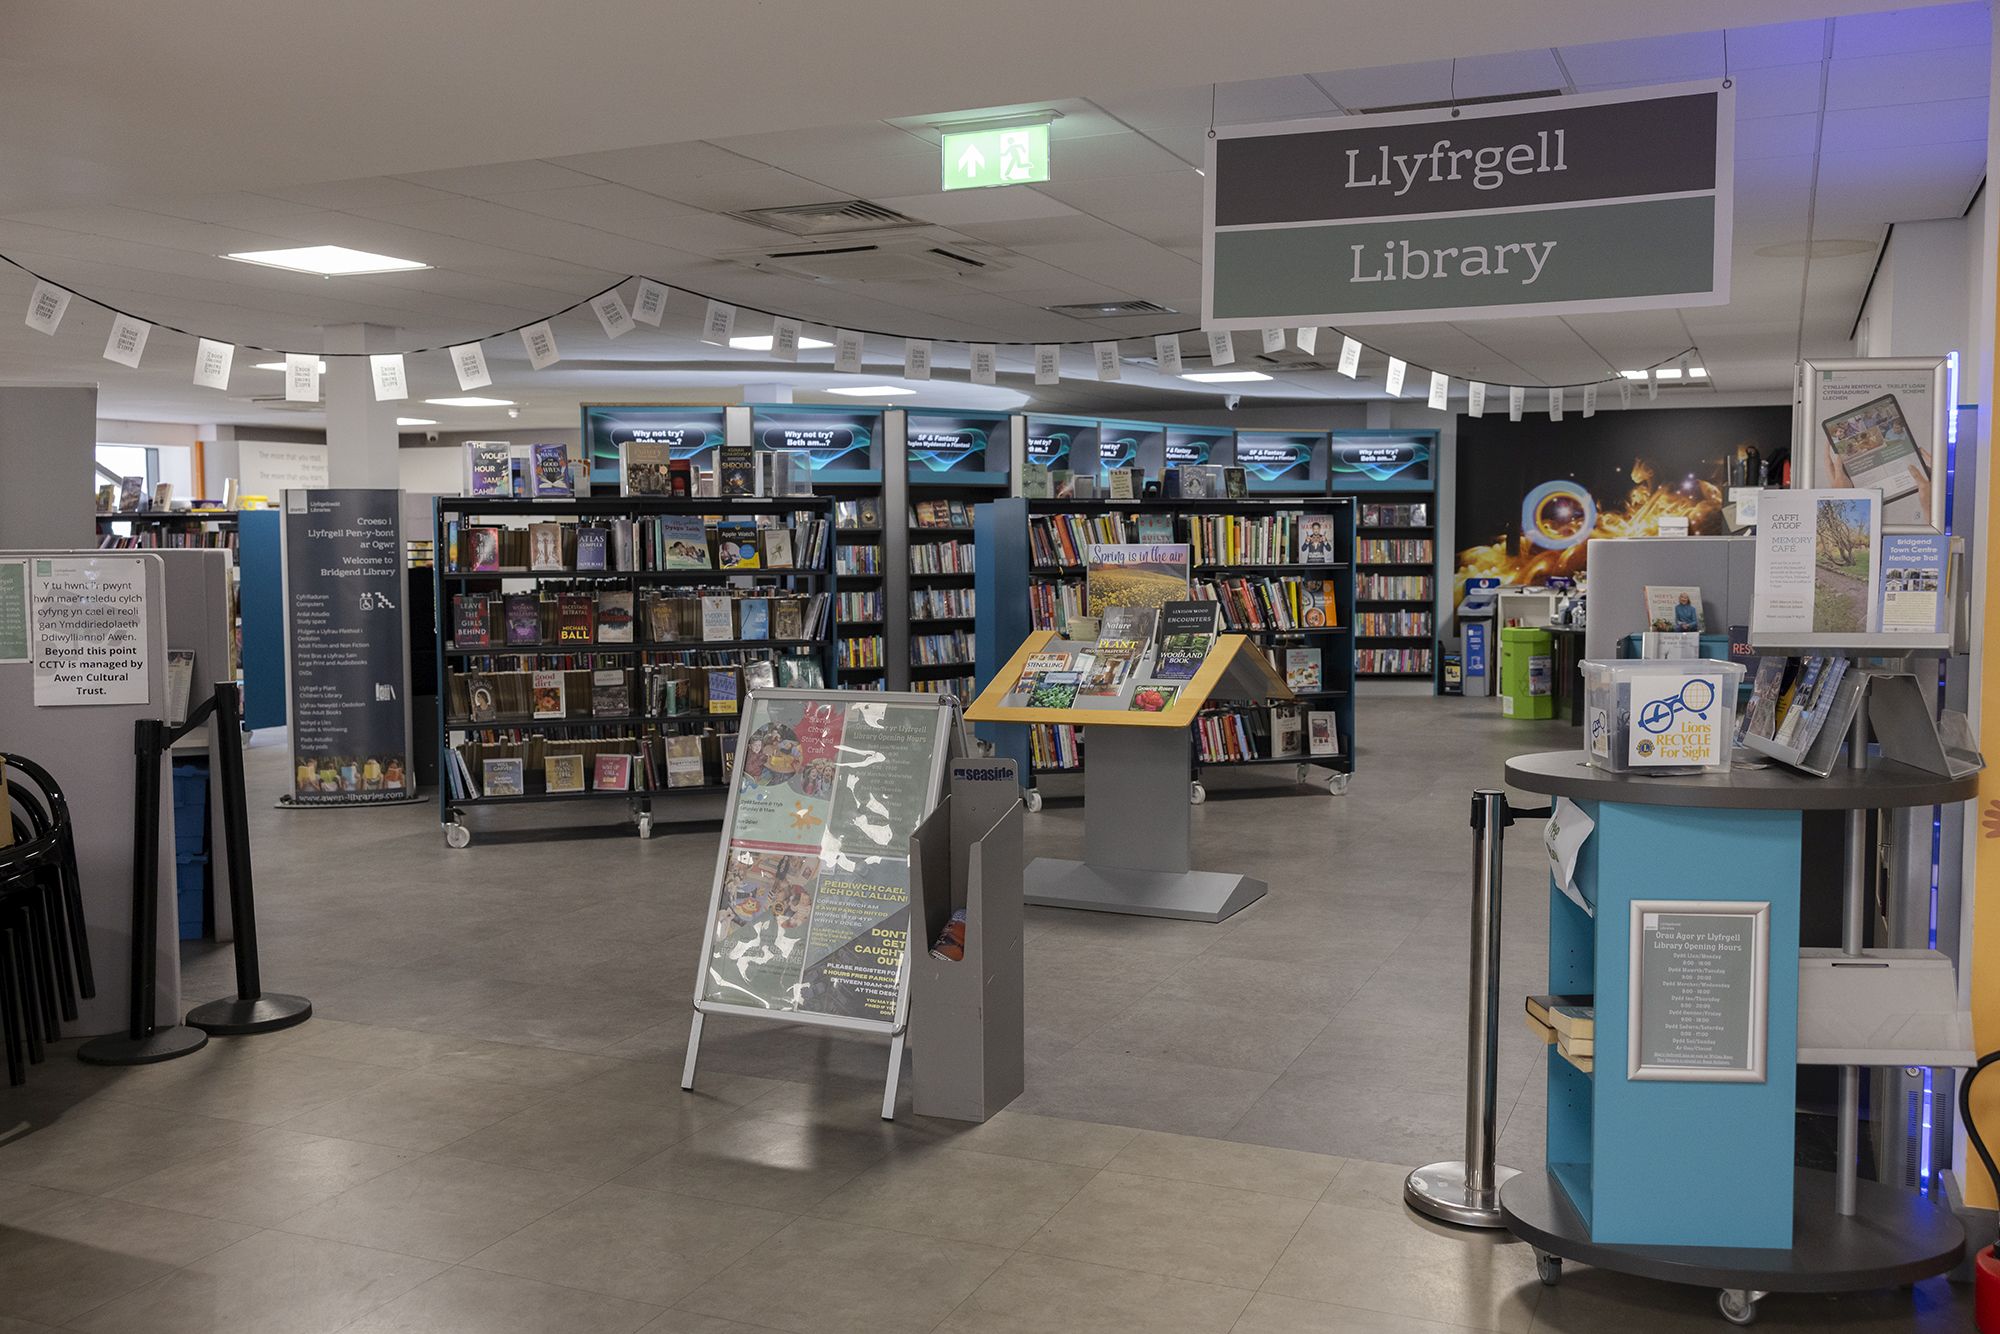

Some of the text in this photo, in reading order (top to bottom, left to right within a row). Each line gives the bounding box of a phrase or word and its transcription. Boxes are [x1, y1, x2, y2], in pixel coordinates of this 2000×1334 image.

[1345, 129, 1567, 196] Llyfrgell
[1350, 240, 1557, 284] Library
[632, 430, 650, 438] Why
[667, 430, 684, 438] try?
[784, 431, 801, 440] Why
[818, 431, 834, 440] try?
[934, 434, 960, 443] Fantasy
[481, 452, 508, 460] VIOLET
[1385, 449, 1399, 457] try?
[357, 517, 387, 525] Croeso
[1772, 514, 1800, 522] CAFFI
[308, 529, 394, 539] Llyfrgell Pen-y-bont
[579, 535, 605, 543] ATLAS
[1771, 536, 1813, 544] MEMORY
[1897, 538, 1932, 546] Bridgend
[372, 541, 395, 550] Ogwr
[342, 556, 382, 564] Welcome
[1093, 545, 1184, 567] Spring is in the air
[1888, 554, 1938, 563] Heritage Trail
[321, 568, 395, 577] Bridgend Library
[102, 582, 132, 591] pwynt
[34, 594, 54, 602] hwn
[86, 594, 116, 602] teledu
[119, 594, 142, 604] cylch
[38, 608, 68, 617] cyfyng
[71, 609, 82, 617] yn
[39, 620, 138, 630] gan Ymddiriedolaeth
[1105, 622, 1132, 630] Nature
[41, 633, 105, 643] Ddiwylliannol
[561, 631, 590, 640] BALL
[1098, 640, 1139, 649] PLANT
[45, 647, 136, 657] Beyond this point
[69, 660, 76, 668] is
[80, 660, 127, 670] managed
[130, 660, 143, 669] by
[86, 673, 129, 681] Cultural
[535, 673, 556, 681] good
[76, 687, 106, 695] Trust.
[1682, 721, 1711, 733] Lions
[1656, 734, 1711, 746] RECYCLE
[1660, 746, 1710, 761] For Sight
[966, 767, 1014, 781] seaside
[824, 880, 906, 894] PEIDIWCH CAEL
[820, 887, 845, 895] EICH
[846, 890, 868, 898] DAL
[1707, 933, 1740, 942] Llyfrgell
[883, 939, 906, 949] GET
[1654, 942, 1742, 951] Library Opening Hours
[827, 962, 887, 975] PLEASE REGISTER
[828, 970, 851, 978] HOURS
[868, 975, 897, 983] PARKIN
